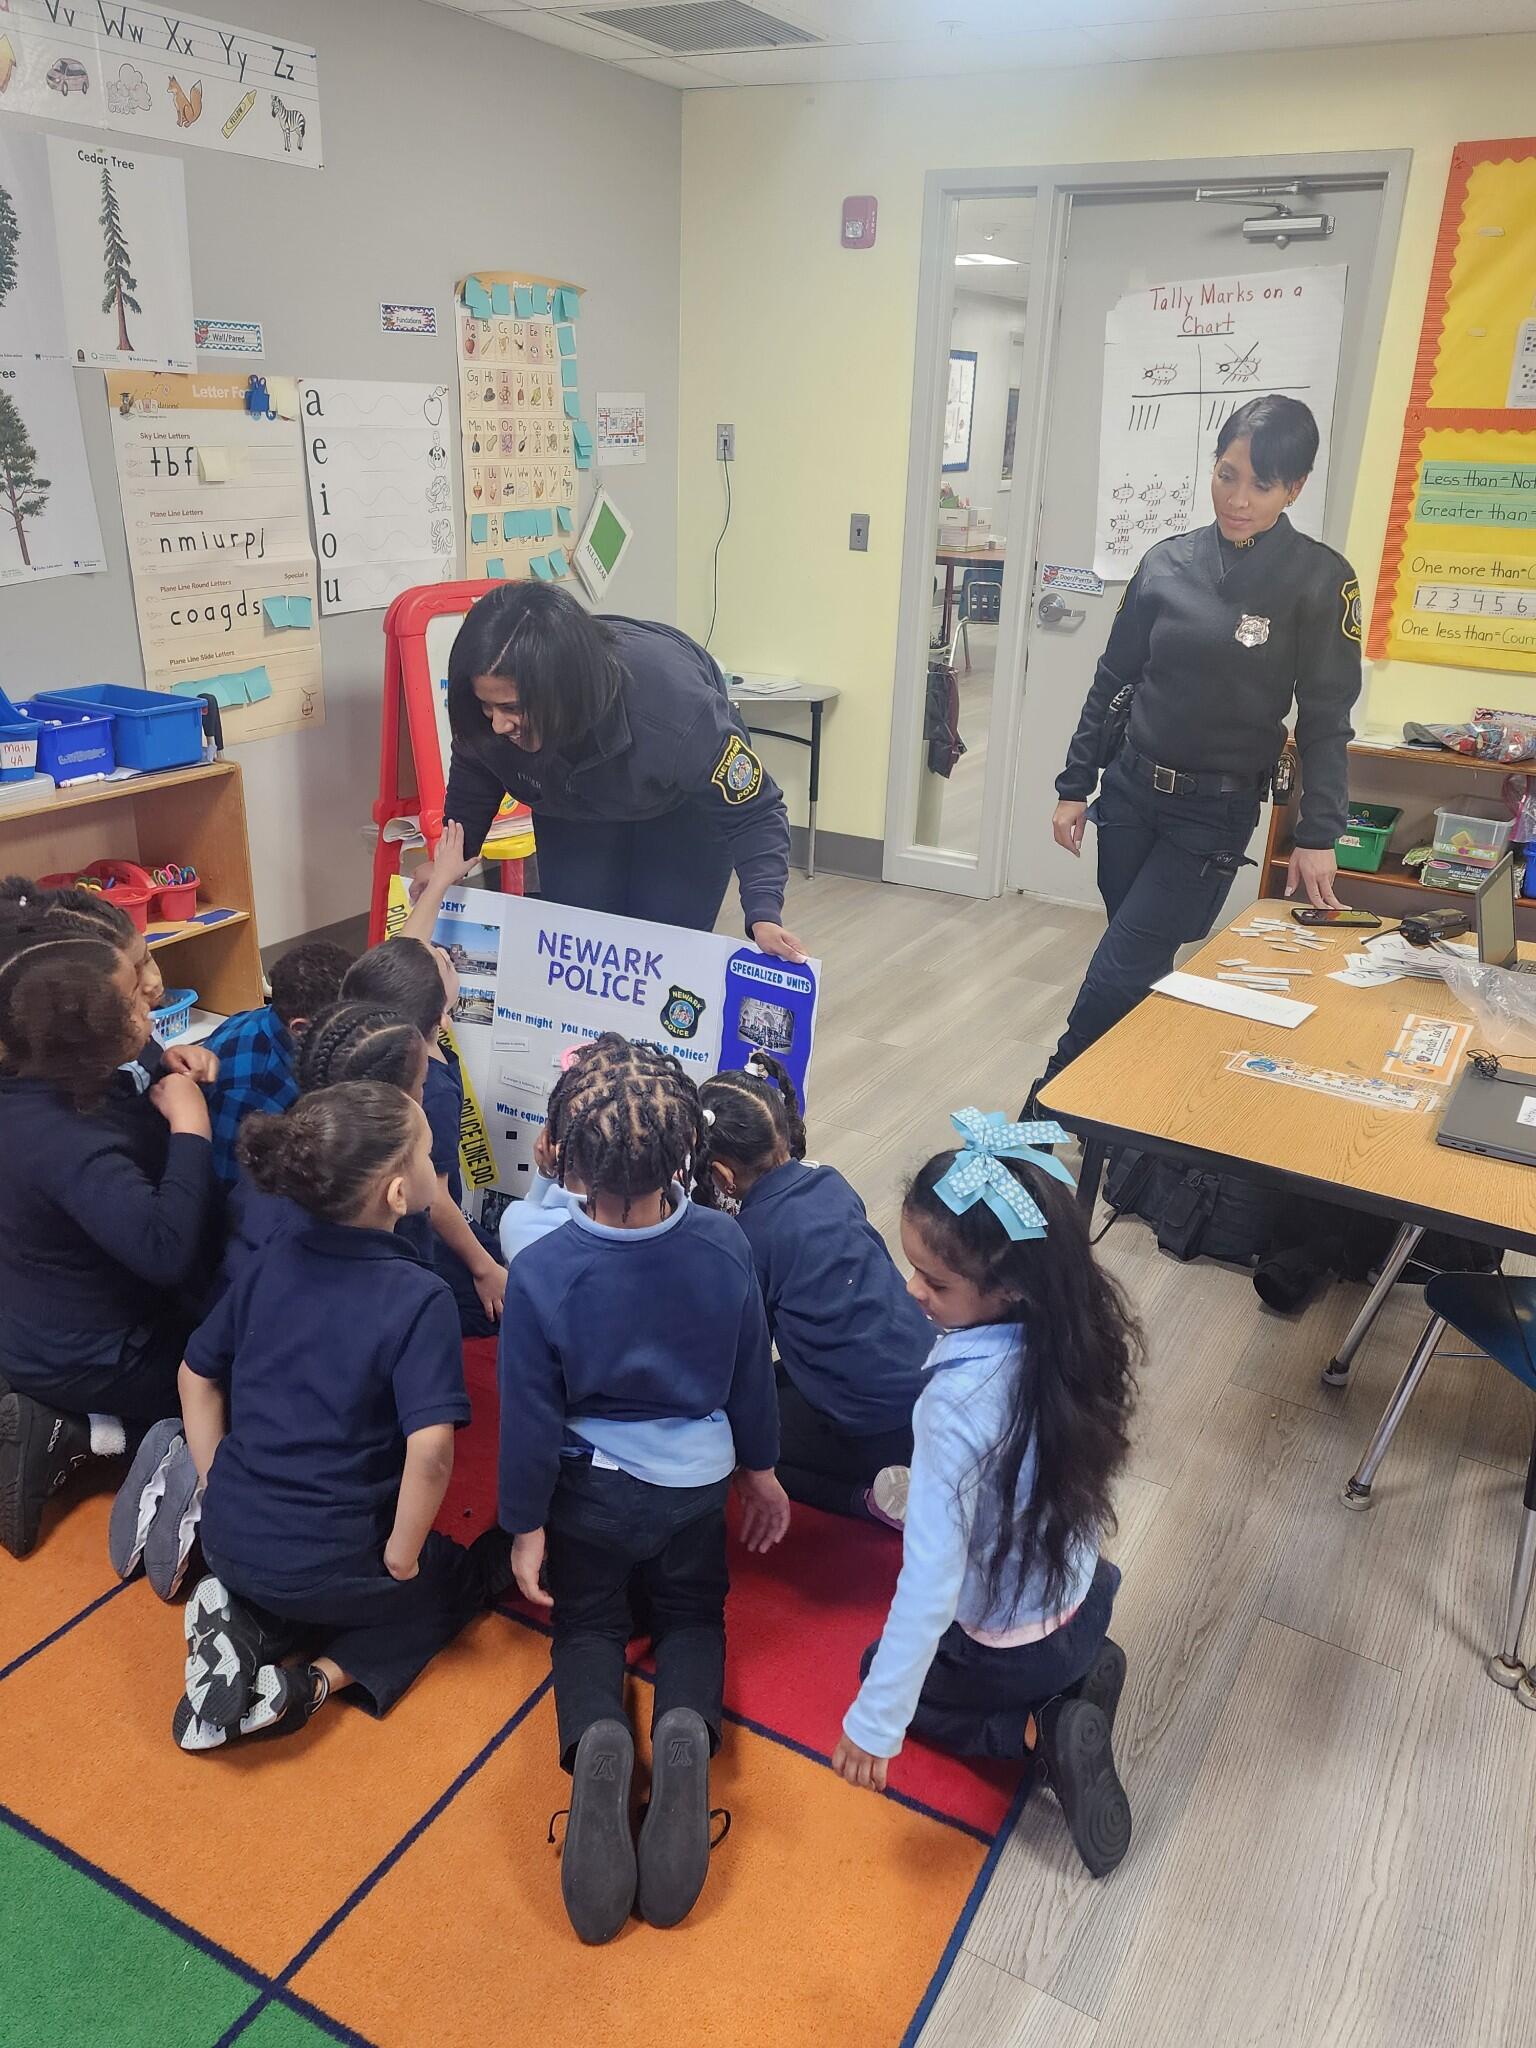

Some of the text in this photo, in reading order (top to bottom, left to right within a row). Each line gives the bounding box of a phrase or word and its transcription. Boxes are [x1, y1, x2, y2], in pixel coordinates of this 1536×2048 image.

[164, 17, 194, 56] Xx
[218, 32, 247, 83] Yy
[272, 46, 295, 80] Zz
[78, 150, 135, 170] Cedar Tree
[1150, 281, 1303, 316] Tally Marks on a
[1182, 312, 1235, 335] Chart
[192, 384, 228, 399] Letter
[305, 389, 324, 417] a
[168, 432, 190, 440] Letters
[312, 438, 328, 464] e
[1424, 468, 1460, 486] Less
[1463, 470, 1497, 487] than
[319, 482, 331, 516] i
[1421, 500, 1483, 519] Greater
[1488, 504, 1528, 521] than
[321, 532, 337, 559] o
[1412, 556, 1444, 573] One
[1448, 565, 1486, 577] more
[324, 577, 342, 604] u
[1414, 590, 1528, 613] 1 2 3 4 5 6
[1401, 619, 1429, 636] One
[1436, 622, 1461, 639] less
[215, 650, 235, 659] Letters
[717, 741, 742, 780] NEWARK
[736, 767, 760, 801] POLICE
[537, 929, 664, 980] NEWARK
[547, 960, 648, 1006] POLICE
[732, 961, 810, 992] SPECIALIZED UNITS
[672, 991, 704, 1010] NEWARK
[497, 1006, 522, 1022] When
[525, 1014, 553, 1029] might
[561, 1022, 578, 1034] you
[672, 1045, 709, 1063] Police?
[664, 1020, 689, 1037] POLICE
[496, 1102, 518, 1117] What
[461, 1136, 490, 1167] LINE
[471, 1166, 495, 1185] DO
